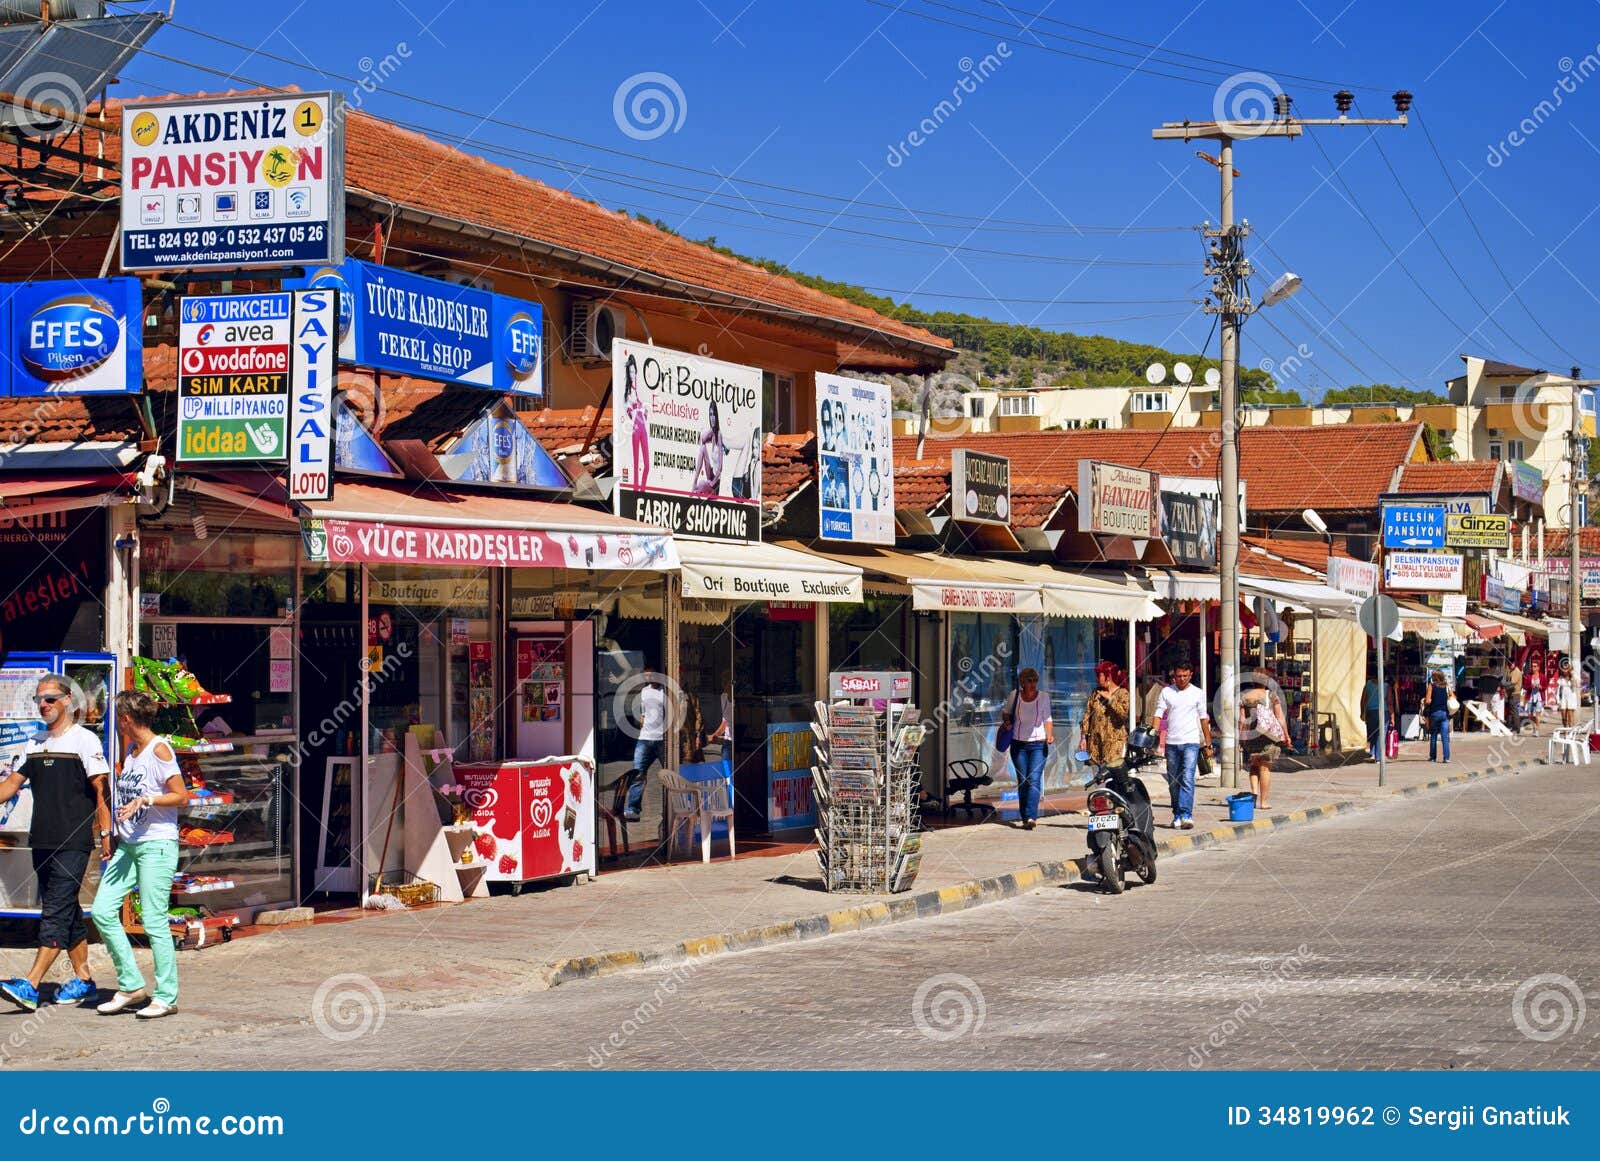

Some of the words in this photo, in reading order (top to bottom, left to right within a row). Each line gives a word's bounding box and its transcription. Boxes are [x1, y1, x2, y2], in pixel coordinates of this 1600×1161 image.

[163, 102, 287, 145] AKDENİZ
[301, 107, 316, 127] 1
[129, 235, 156, 249] TEL:
[159, 232, 181, 248] 824
[184, 232, 199, 247] 92
[202, 231, 217, 246] 09
[227, 231, 235, 245] 0
[238, 229, 260, 245] 532
[263, 228, 286, 243] 437
[289, 227, 304, 242] 05
[308, 226, 323, 241] 26
[154, 248, 294, 263] www.akdenizpansiyon1.com
[210, 299, 287, 320] TURKCELL
[366, 277, 406, 321] YÜCE
[409, 292, 488, 341] KARDEŞLER
[30, 317, 104, 349] EFES
[224, 324, 274, 342] avea
[48, 352, 84, 363] Pilsen
[208, 350, 286, 371] vodafone
[378, 332, 430, 367] TEKEL
[433, 342, 472, 370] SHOP
[229, 376, 281, 394] KART
[296, 292, 328, 463] SAYISAL
[643, 357, 672, 394] Ori
[676, 366, 756, 414] Boutique
[652, 395, 700, 421] Exclusive
[186, 426, 247, 453] iddaa
[495, 433, 512, 449] EFES
[292, 473, 327, 494] LOTO
[636, 498, 681, 531] FABRIC
[686, 505, 747, 537] SHOPPING
[1103, 510, 1148, 537] BOUTIQUE
[1396, 511, 1434, 522] BELSİN
[1460, 517, 1506, 530] Ginza
[38, 533, 66, 542] DRINK
[1388, 523, 1441, 536] PANSİYON
[357, 523, 418, 558] YÜCE
[425, 531, 544, 567] KARDEŞLER
[703, 576, 723, 591] Ori
[733, 577, 790, 597] Boutique
[802, 580, 851, 597] Exclusive
[842, 679, 879, 691] SABAH
